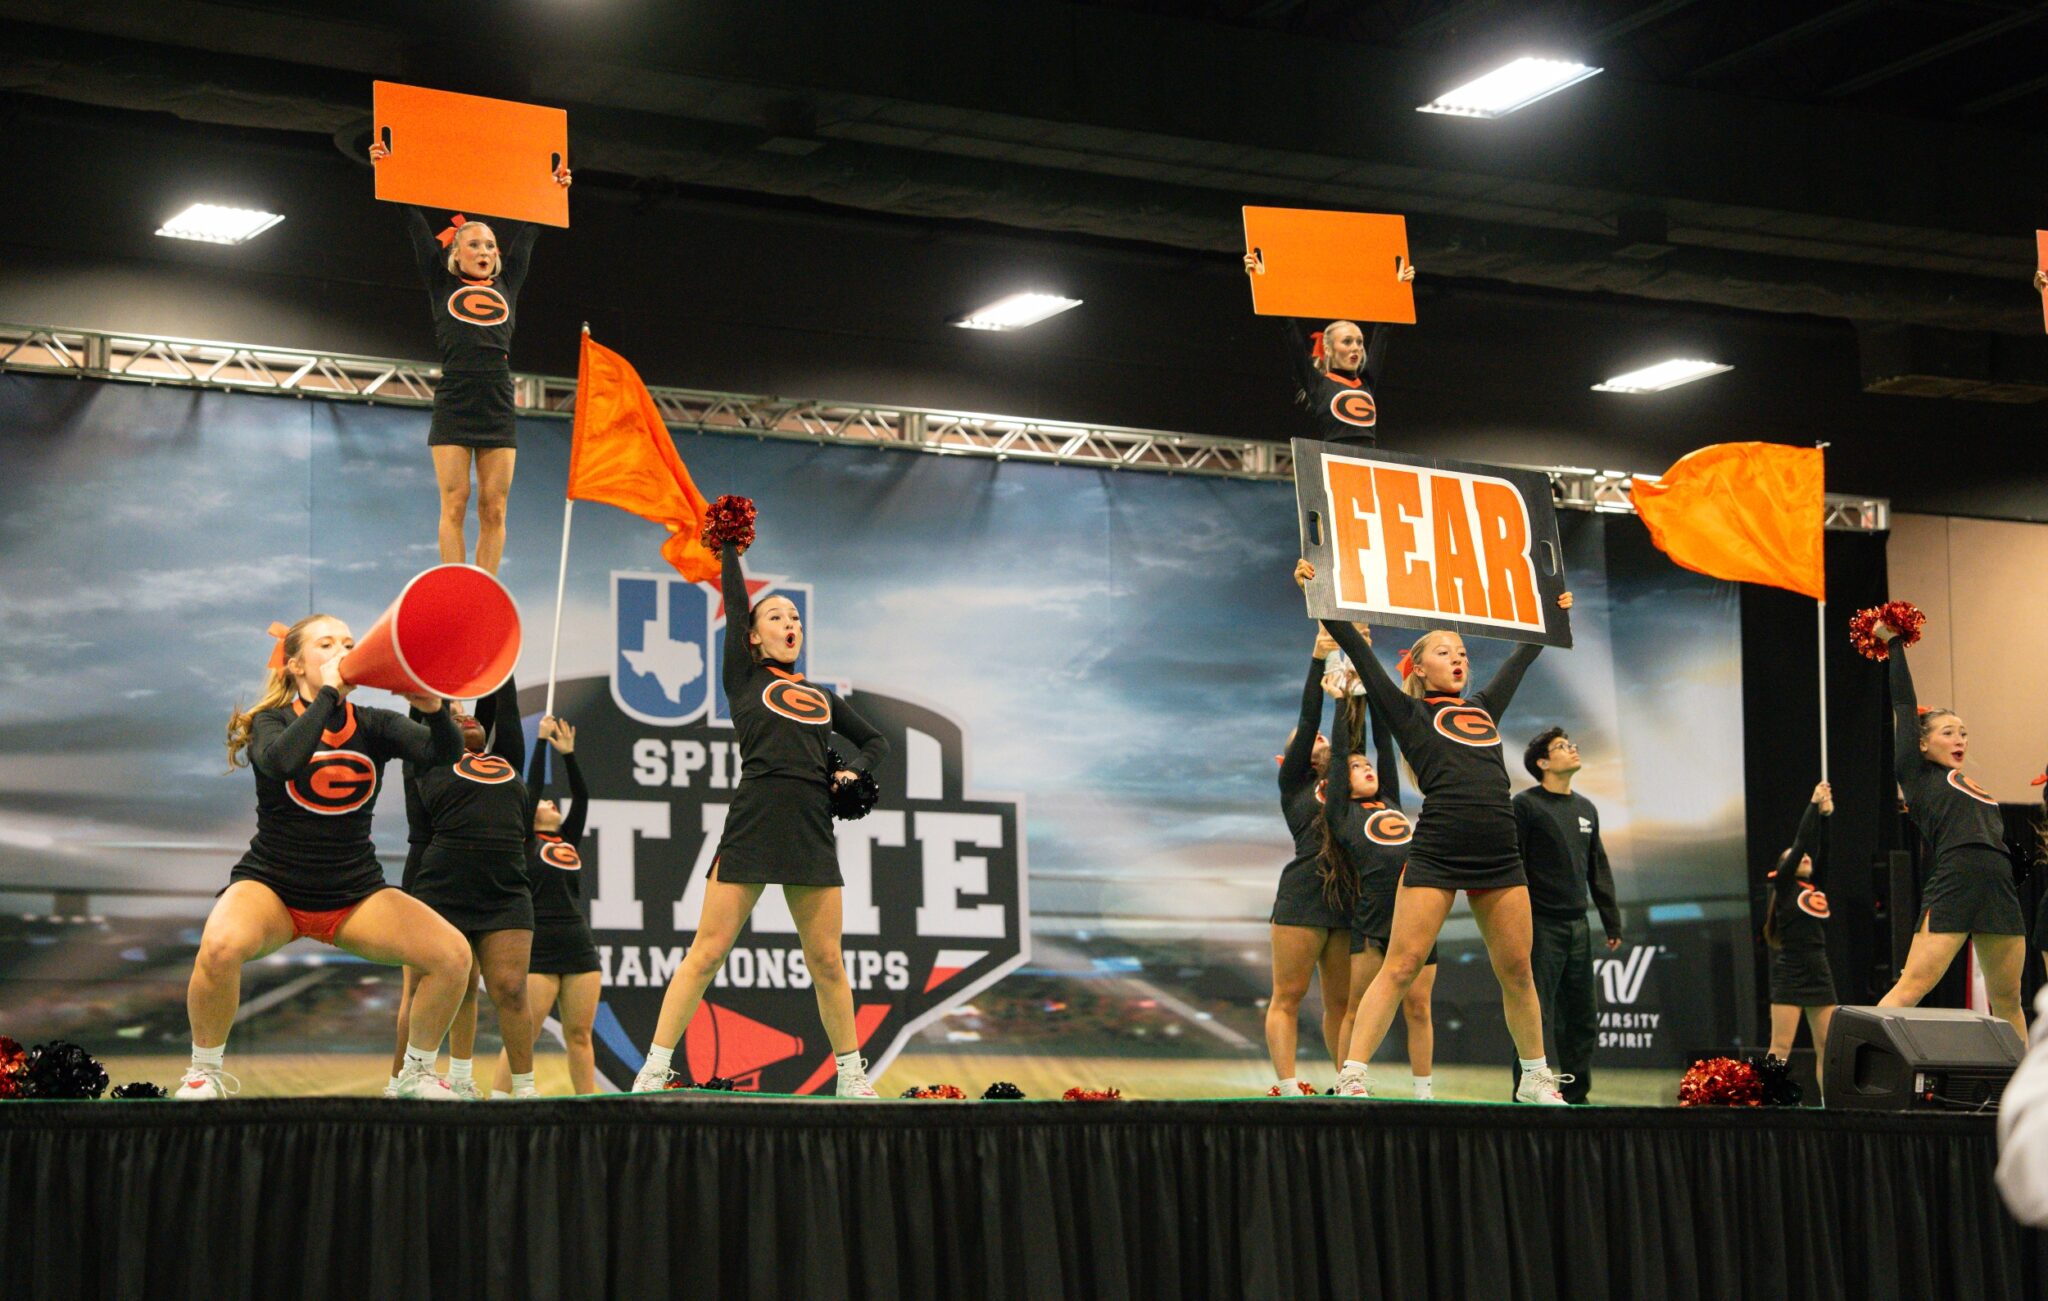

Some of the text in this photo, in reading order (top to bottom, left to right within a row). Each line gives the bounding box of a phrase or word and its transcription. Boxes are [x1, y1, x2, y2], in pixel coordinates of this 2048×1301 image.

[449, 286, 509, 326] G
[1331, 390, 1377, 426] G
[1326, 459, 1541, 626] FEAR
[763, 680, 831, 723] G
[1435, 707, 1501, 746] G
[286, 751, 376, 815] G
[453, 754, 515, 784] G
[633, 738, 743, 790] SPI
[1366, 809, 1412, 845] G
[541, 843, 582, 870] G
[560, 798, 1006, 939] TTE
[597, 945, 909, 990] HAMONSIPS
[1597, 1012, 1660, 1029] ARSITY
[1598, 1032, 1653, 1049] SPIRIT
